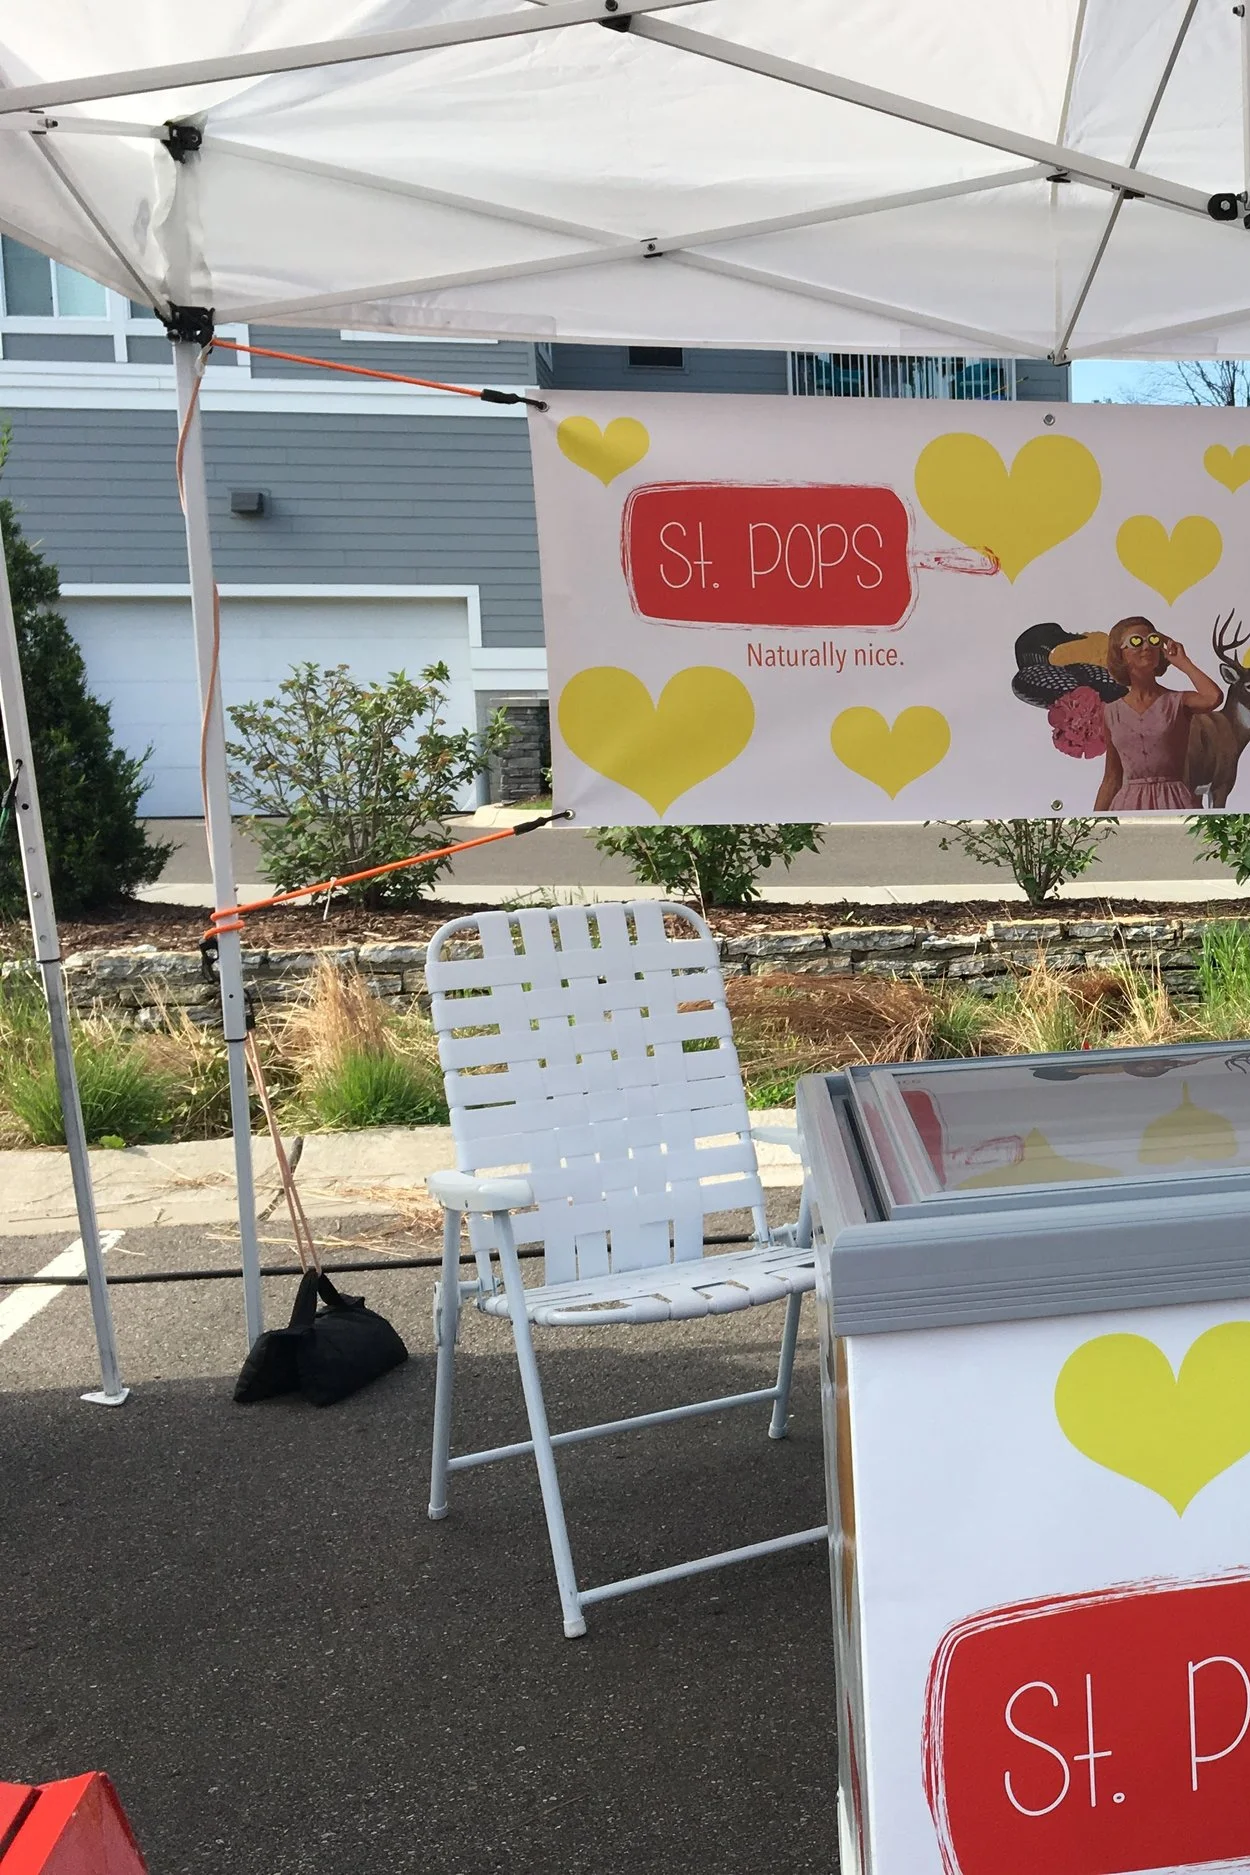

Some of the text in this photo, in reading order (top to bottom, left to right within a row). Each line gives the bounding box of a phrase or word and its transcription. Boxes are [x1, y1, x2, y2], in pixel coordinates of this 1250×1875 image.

[659, 521, 884, 590] St. POPS
[746, 641, 905, 674] Naturally nice.
[1003, 1673, 1127, 1817] St.
